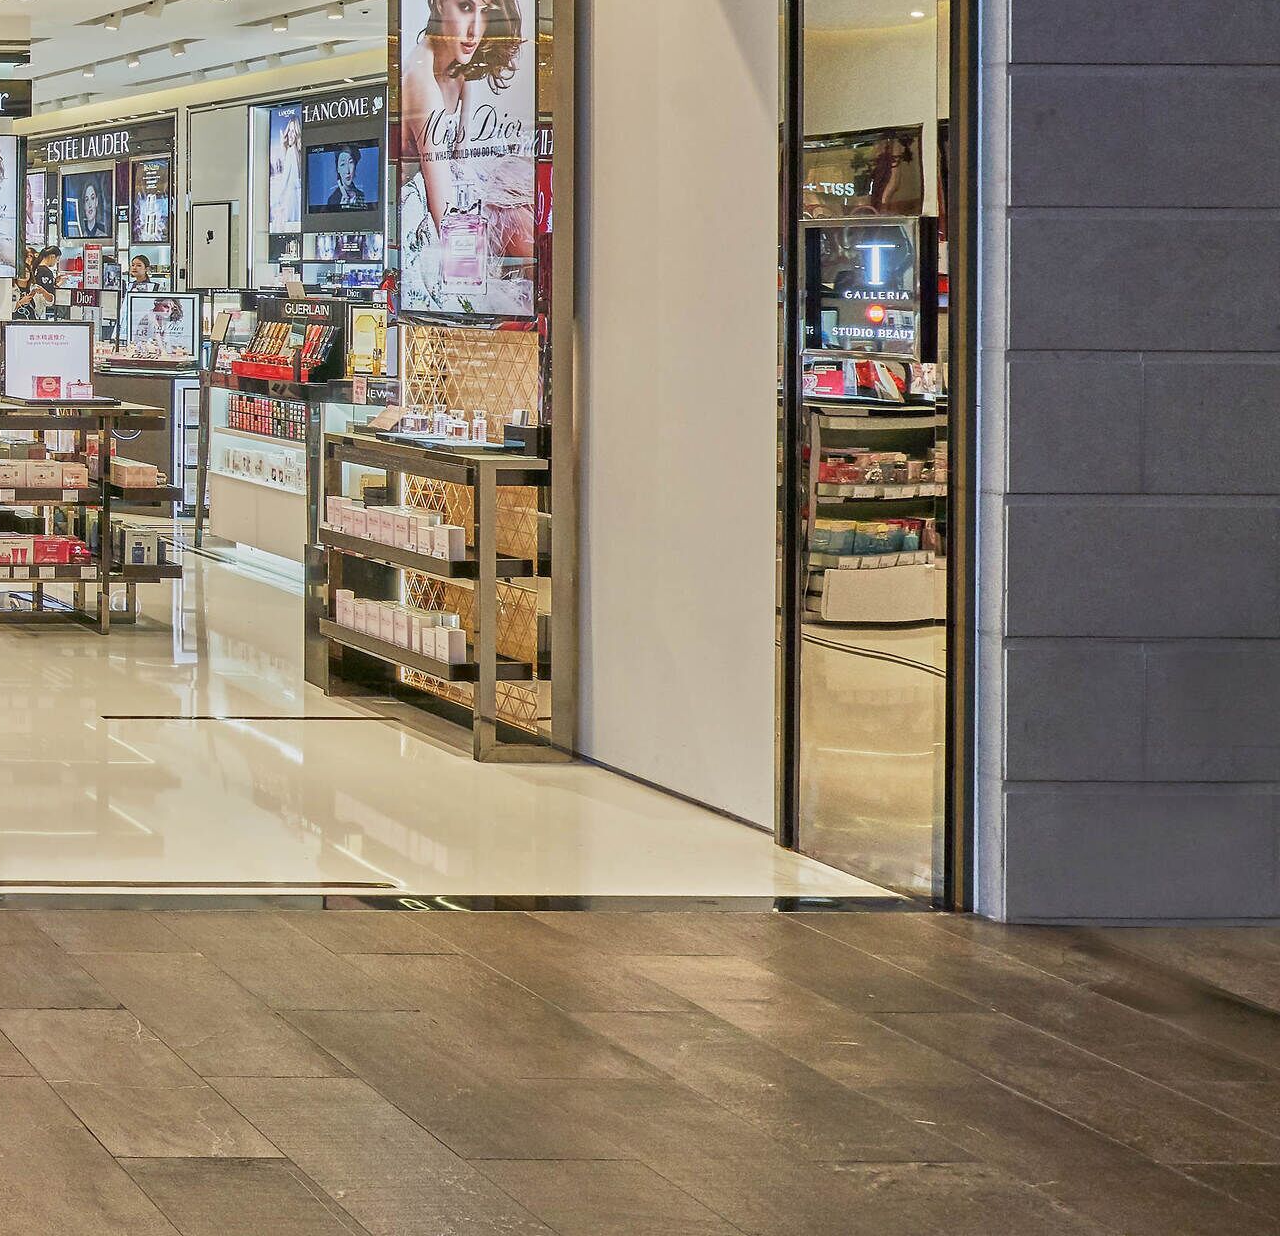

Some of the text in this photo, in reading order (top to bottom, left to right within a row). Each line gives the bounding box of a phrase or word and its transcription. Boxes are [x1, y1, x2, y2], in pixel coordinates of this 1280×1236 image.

[416, 104, 523, 147] Miss Dior
[81, 131, 130, 158] LAUDER
[76, 290, 94, 305] Dior
[346, 289, 360, 298] Dior
[844, 290, 910, 300] GALLERIA
[284, 302, 330, 316] GUERLAIN
[831, 326, 914, 339] STUDIO BEAUT
